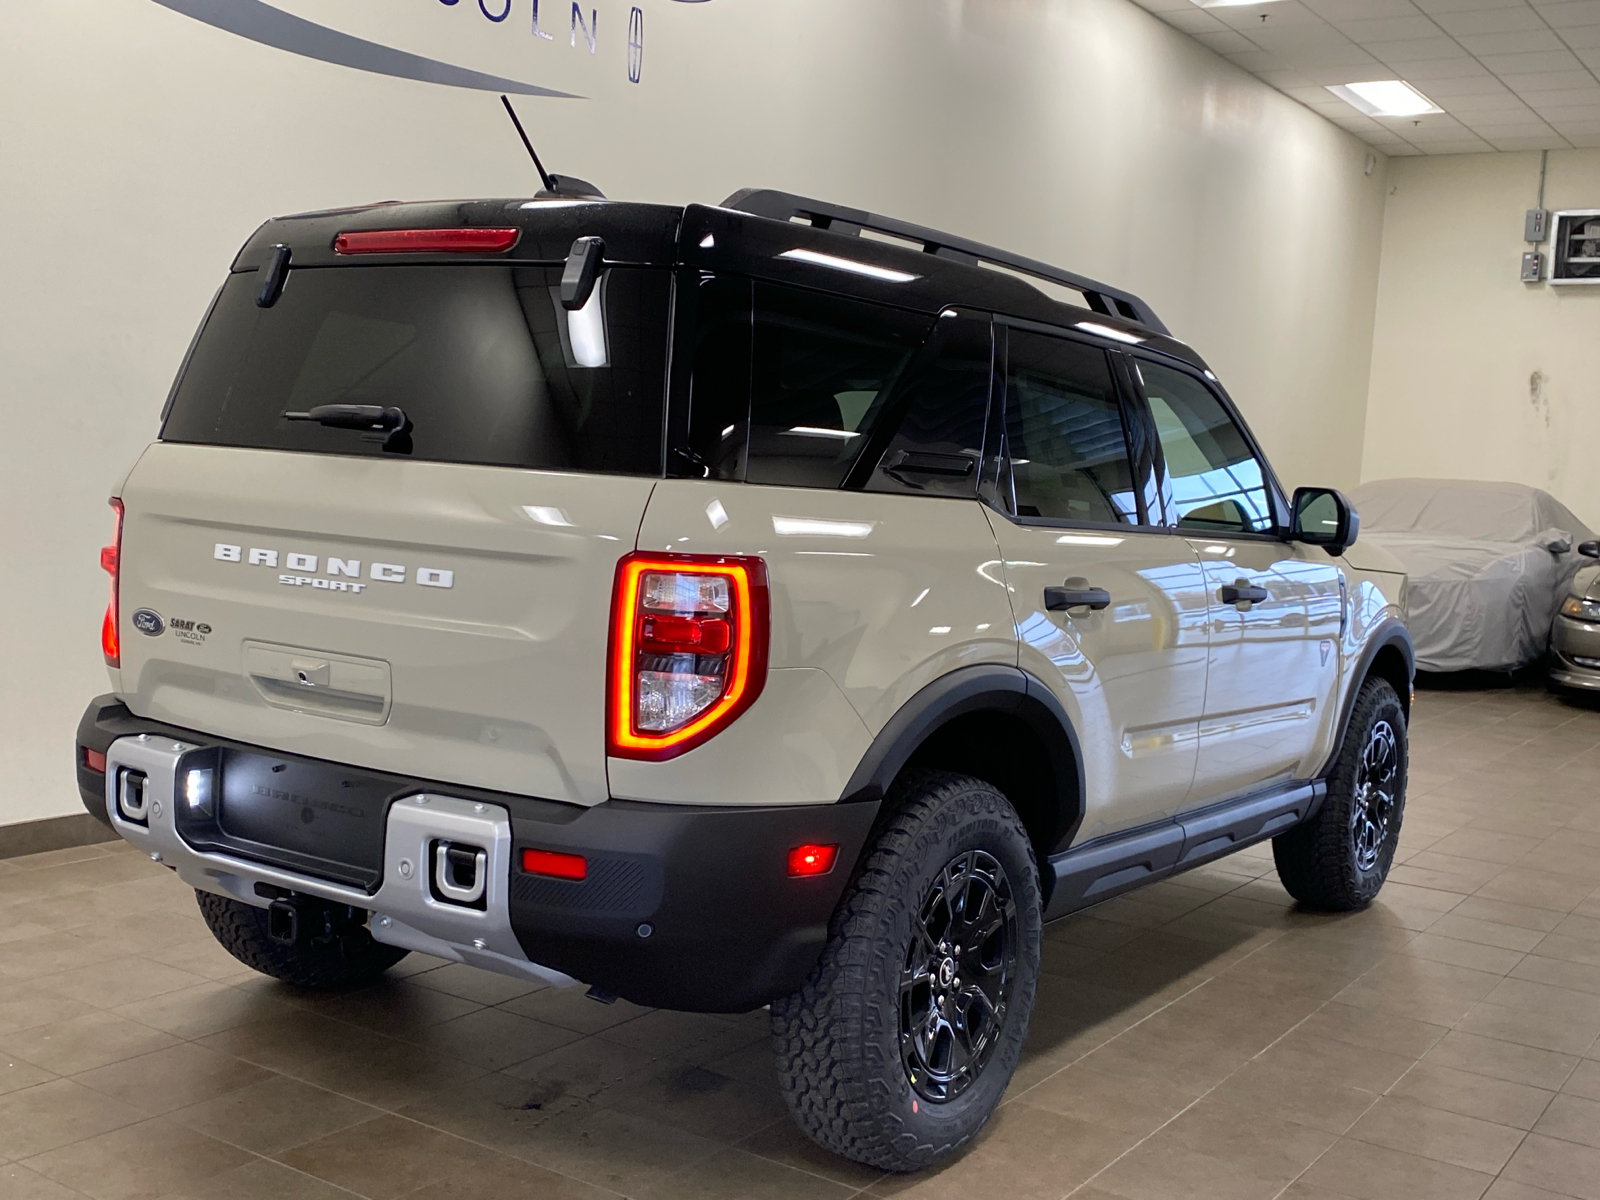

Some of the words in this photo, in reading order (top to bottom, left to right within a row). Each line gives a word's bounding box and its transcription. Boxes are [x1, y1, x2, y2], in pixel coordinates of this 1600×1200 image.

[213, 542, 455, 589] BRONCO
[278, 574, 367, 594] SPORT
[170, 617, 195, 631] SARAT
[175, 630, 205, 641] LINCOLN
[253, 785, 365, 818] BRONCO
